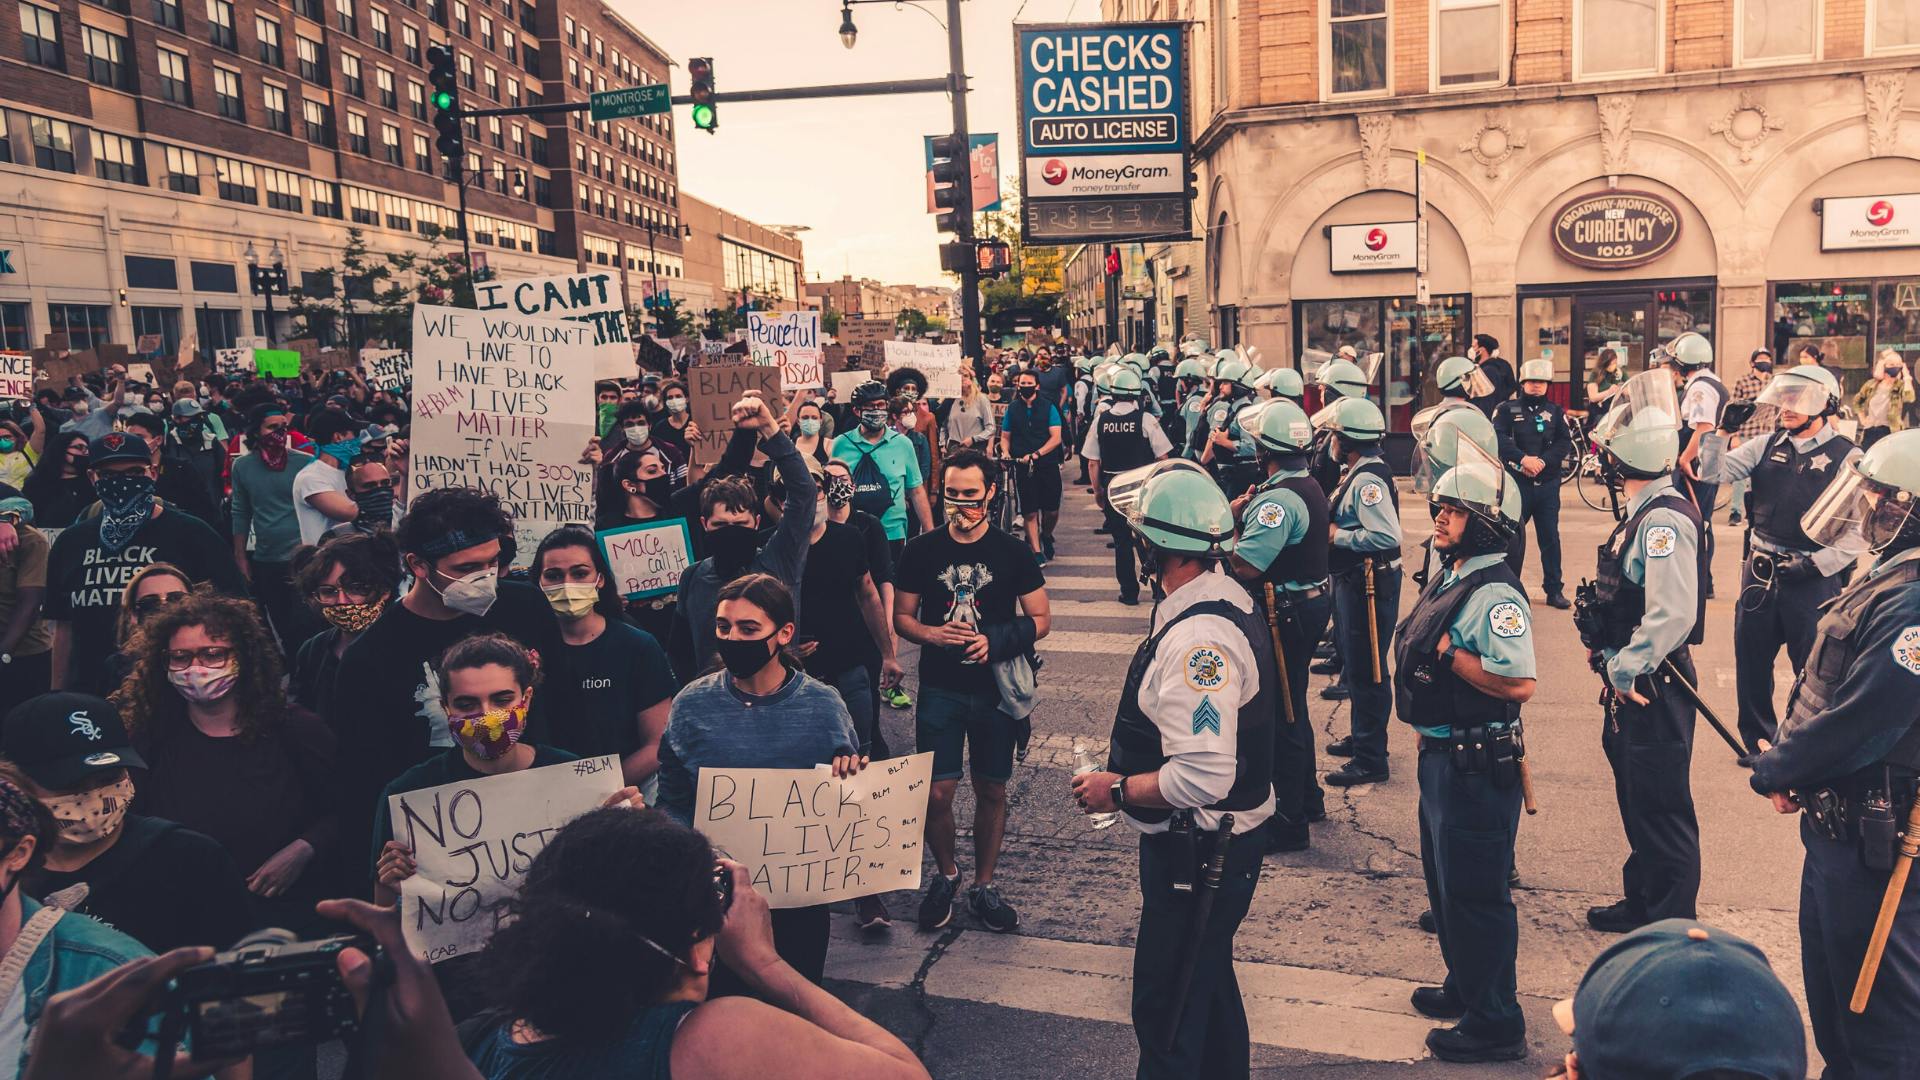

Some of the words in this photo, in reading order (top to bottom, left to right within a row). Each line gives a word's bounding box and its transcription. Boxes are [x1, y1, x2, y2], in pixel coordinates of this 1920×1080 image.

[1031, 34, 1172, 73] CHECKS
[602, 89, 653, 106] MONTROSE
[1032, 74, 1173, 113] CASHED
[1040, 122, 1088, 141] AUTO
[1093, 120, 1168, 139] LICENSE
[1072, 165, 1168, 182] MoneyGram
[1072, 186, 1103, 194] money
[1104, 183, 1141, 191] transfer
[1605, 209, 1625, 219] NEW
[1574, 217, 1657, 243] CURRENCY
[1850, 228, 1909, 237] MoneyGram
[1352, 253, 1400, 262] MoneyGram
[1597, 244, 1634, 257] 1002
[478, 285, 508, 310] I
[514, 273, 610, 315] CANT
[421, 310, 467, 338] WE
[482, 317, 590, 345] WOULDN'T
[750, 313, 816, 348] Peaceful
[466, 340, 513, 362] HAVE
[529, 343, 552, 369] TO
[437, 359, 495, 385] HAVE
[507, 367, 568, 392] BLACK
[700, 371, 777, 396] BLACK
[416, 385, 464, 420] #BLM
[471, 389, 548, 416] LIVES
[457, 410, 549, 440] MATTER
[1103, 422, 1136, 433] POLICE
[501, 441, 533, 462] WE
[414, 454, 480, 474] HADN'T
[489, 461, 530, 478] HAD
[415, 474, 434, 490] OF
[527, 481, 584, 503] LIVES
[647, 550, 671, 573] call
[71, 588, 127, 608] MATT
[1493, 604, 1522, 620] CHICAGO
[1498, 624, 1523, 635] POLICE
[1189, 649, 1224, 668] CHICAGO
[1193, 674, 1222, 686] POLICE
[69, 710, 102, 741] Sox
[574, 758, 613, 777] #BLM
[888, 759, 909, 775] BLM
[872, 787, 891, 800] BLM
[909, 779, 924, 792] BLM
[400, 789, 482, 858] NO
[902, 817, 917, 826] BLM
[902, 841, 917, 850] BLM
[446, 825, 565, 888] JUST
[752, 855, 866, 894] ATTER.
[416, 886, 482, 932] NO
